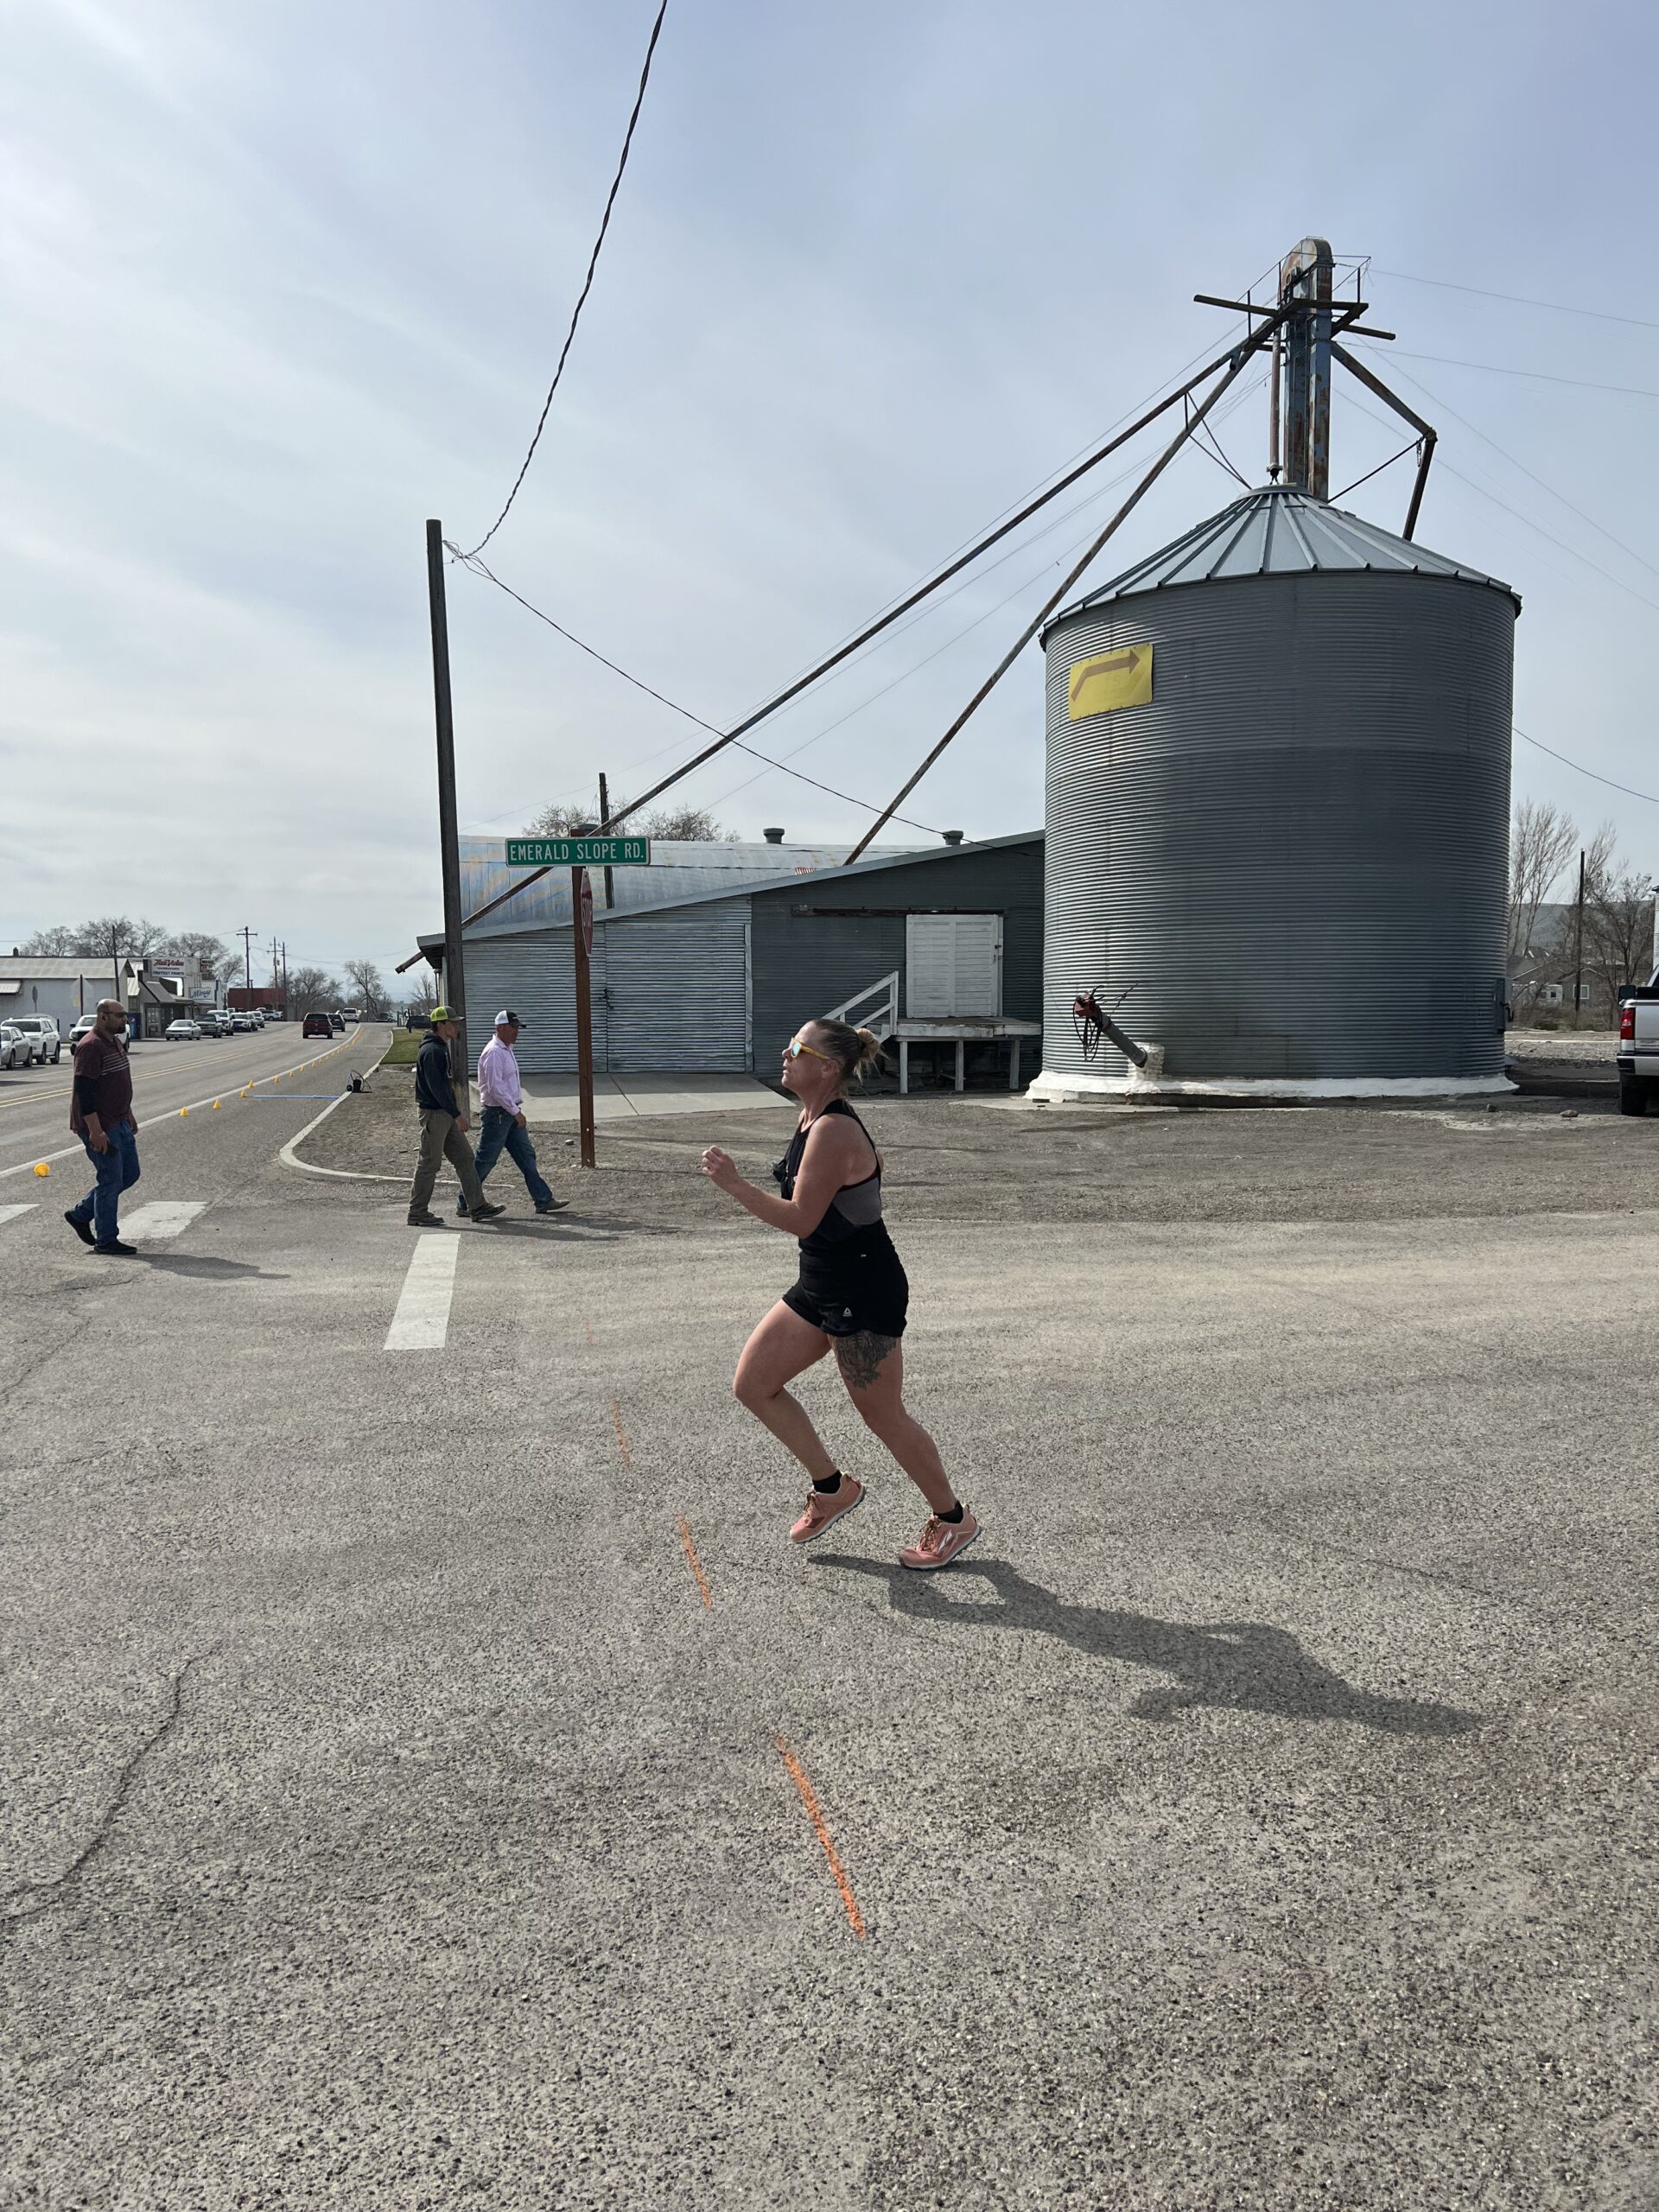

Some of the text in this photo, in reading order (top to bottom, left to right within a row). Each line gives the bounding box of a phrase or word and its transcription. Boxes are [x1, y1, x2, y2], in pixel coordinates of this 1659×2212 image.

[510, 842, 644, 861] EMERALD SLOPE RD.
